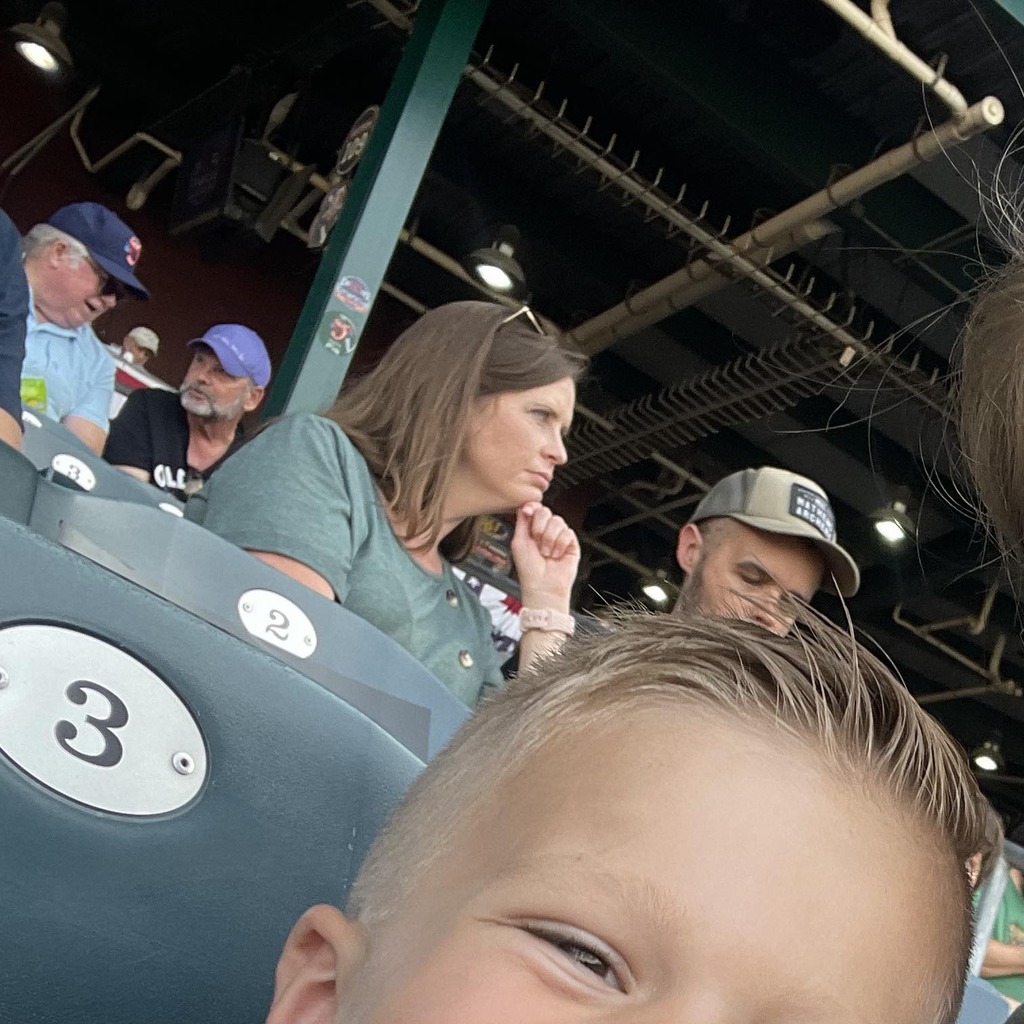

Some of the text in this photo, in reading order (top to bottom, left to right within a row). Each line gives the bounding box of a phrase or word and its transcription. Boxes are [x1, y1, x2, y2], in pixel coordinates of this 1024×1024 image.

[68, 464, 81, 481] 3
[265, 608, 290, 641] 2
[54, 680, 129, 768] 3
